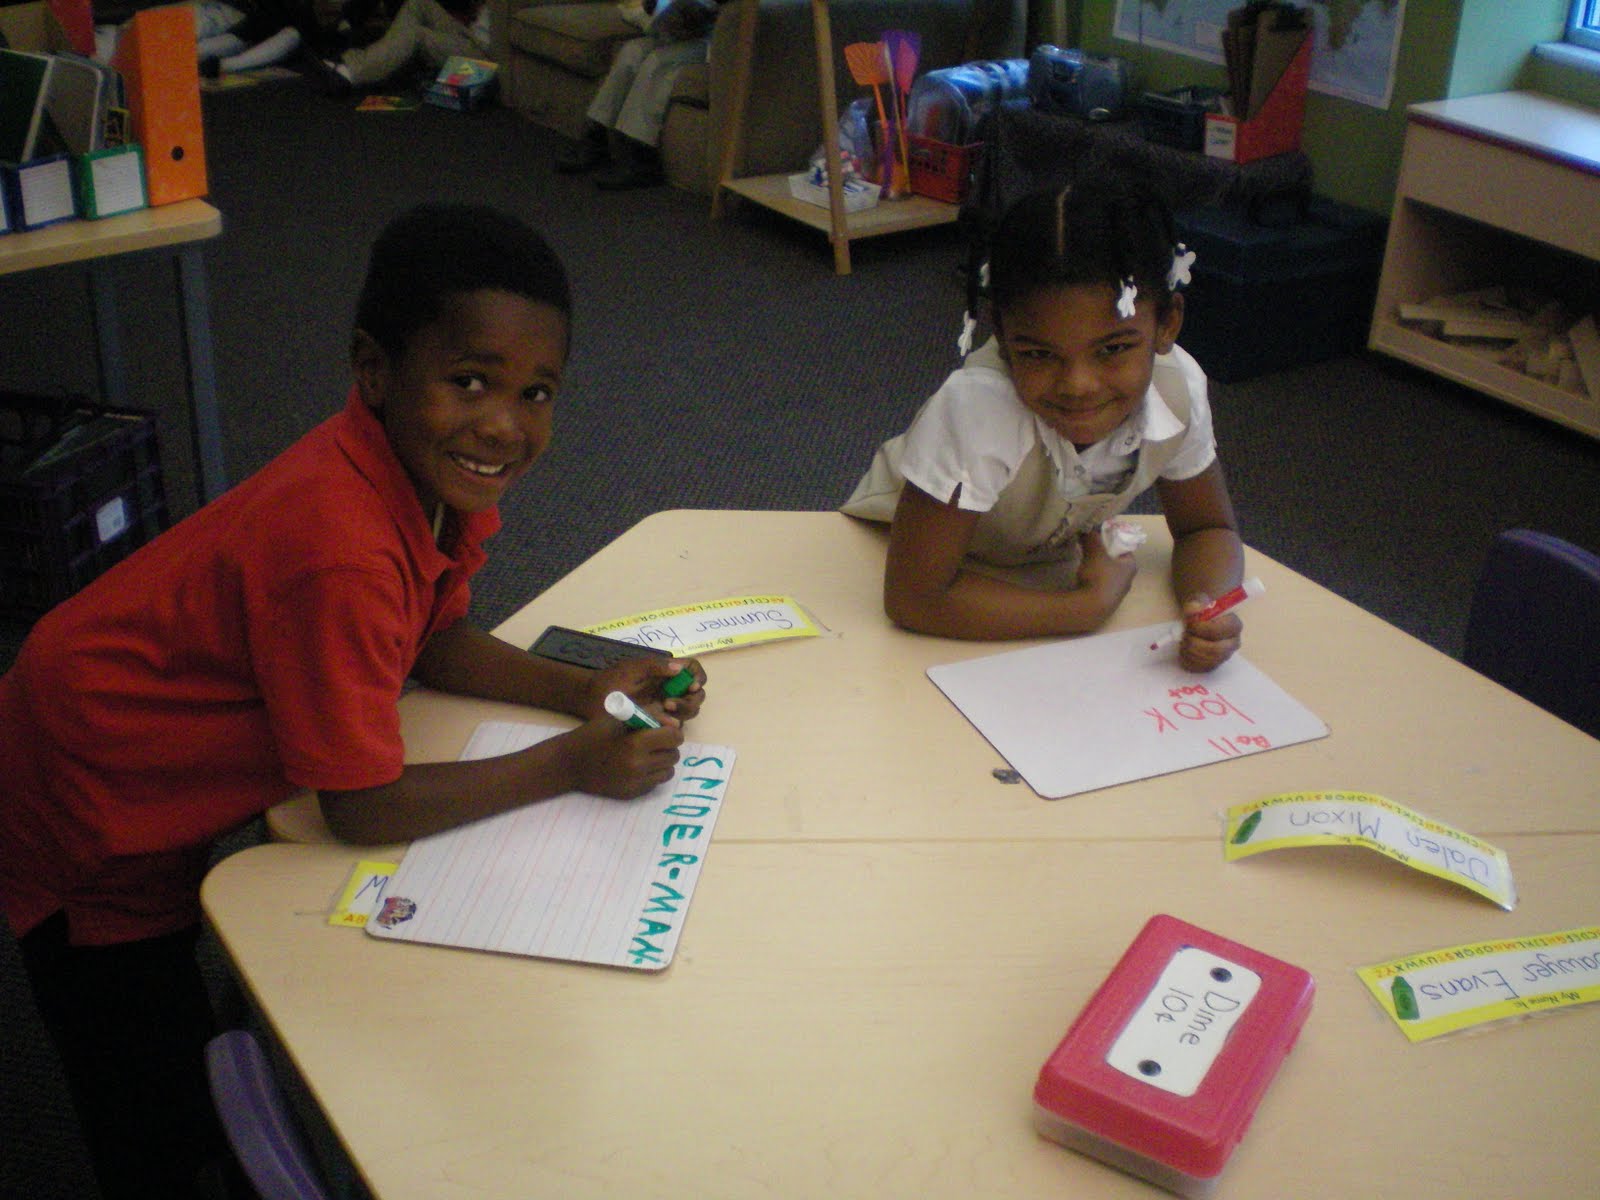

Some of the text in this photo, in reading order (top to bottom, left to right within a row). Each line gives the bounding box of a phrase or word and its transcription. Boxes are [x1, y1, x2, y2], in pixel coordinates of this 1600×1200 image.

[694, 608, 794, 634] Summer
[717, 636, 734, 646] My
[1288, 809, 1490, 889] Jalen Mixon
[1419, 968, 1521, 1002] Evans
[1560, 990, 1581, 1003] My
[1528, 994, 1559, 1006] Name
[1178, 990, 1241, 1046] Dime
